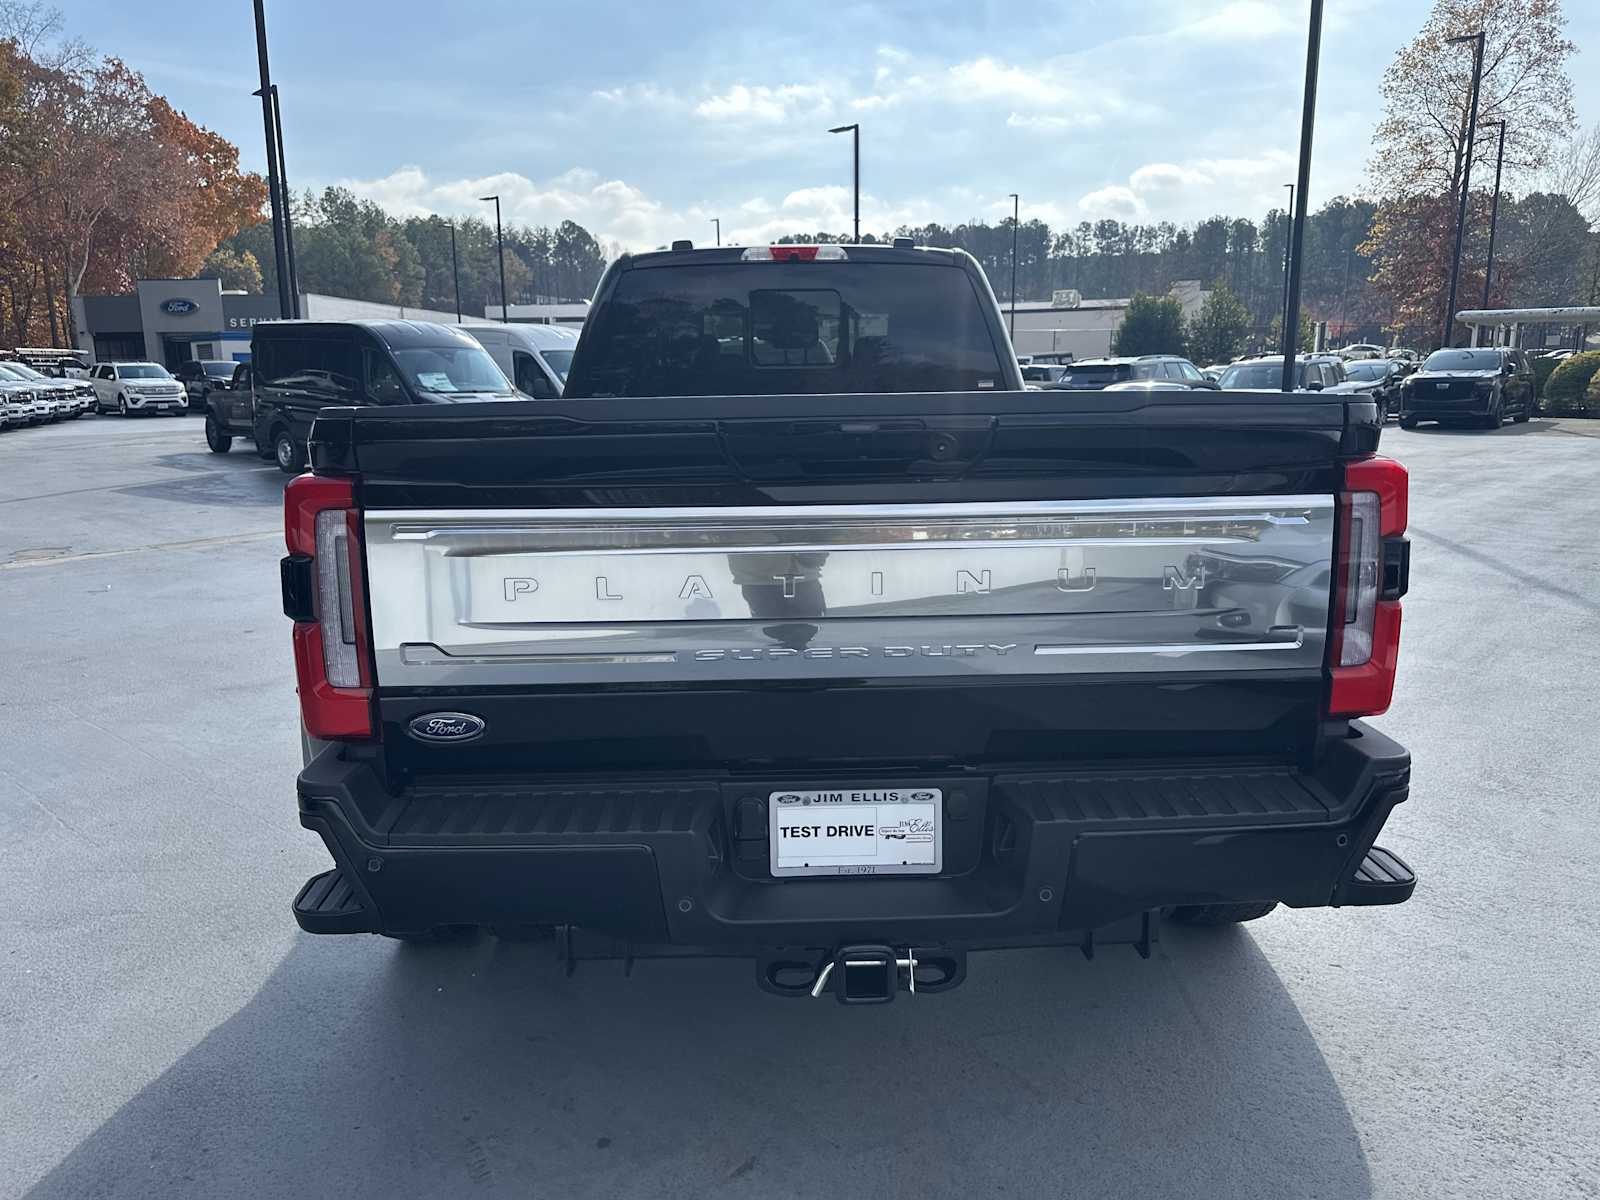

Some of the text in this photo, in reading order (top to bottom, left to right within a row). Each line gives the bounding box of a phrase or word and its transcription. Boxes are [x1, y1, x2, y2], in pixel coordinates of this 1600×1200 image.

[167, 302, 190, 312] Ford
[503, 564, 1206, 601] PLATINUM
[695, 643, 1017, 661] SUPER DUTY
[426, 719, 467, 734] Ford
[813, 793, 843, 803] JIM
[851, 791, 899, 803] ELLIS
[780, 825, 875, 838] TEST DRIVE
